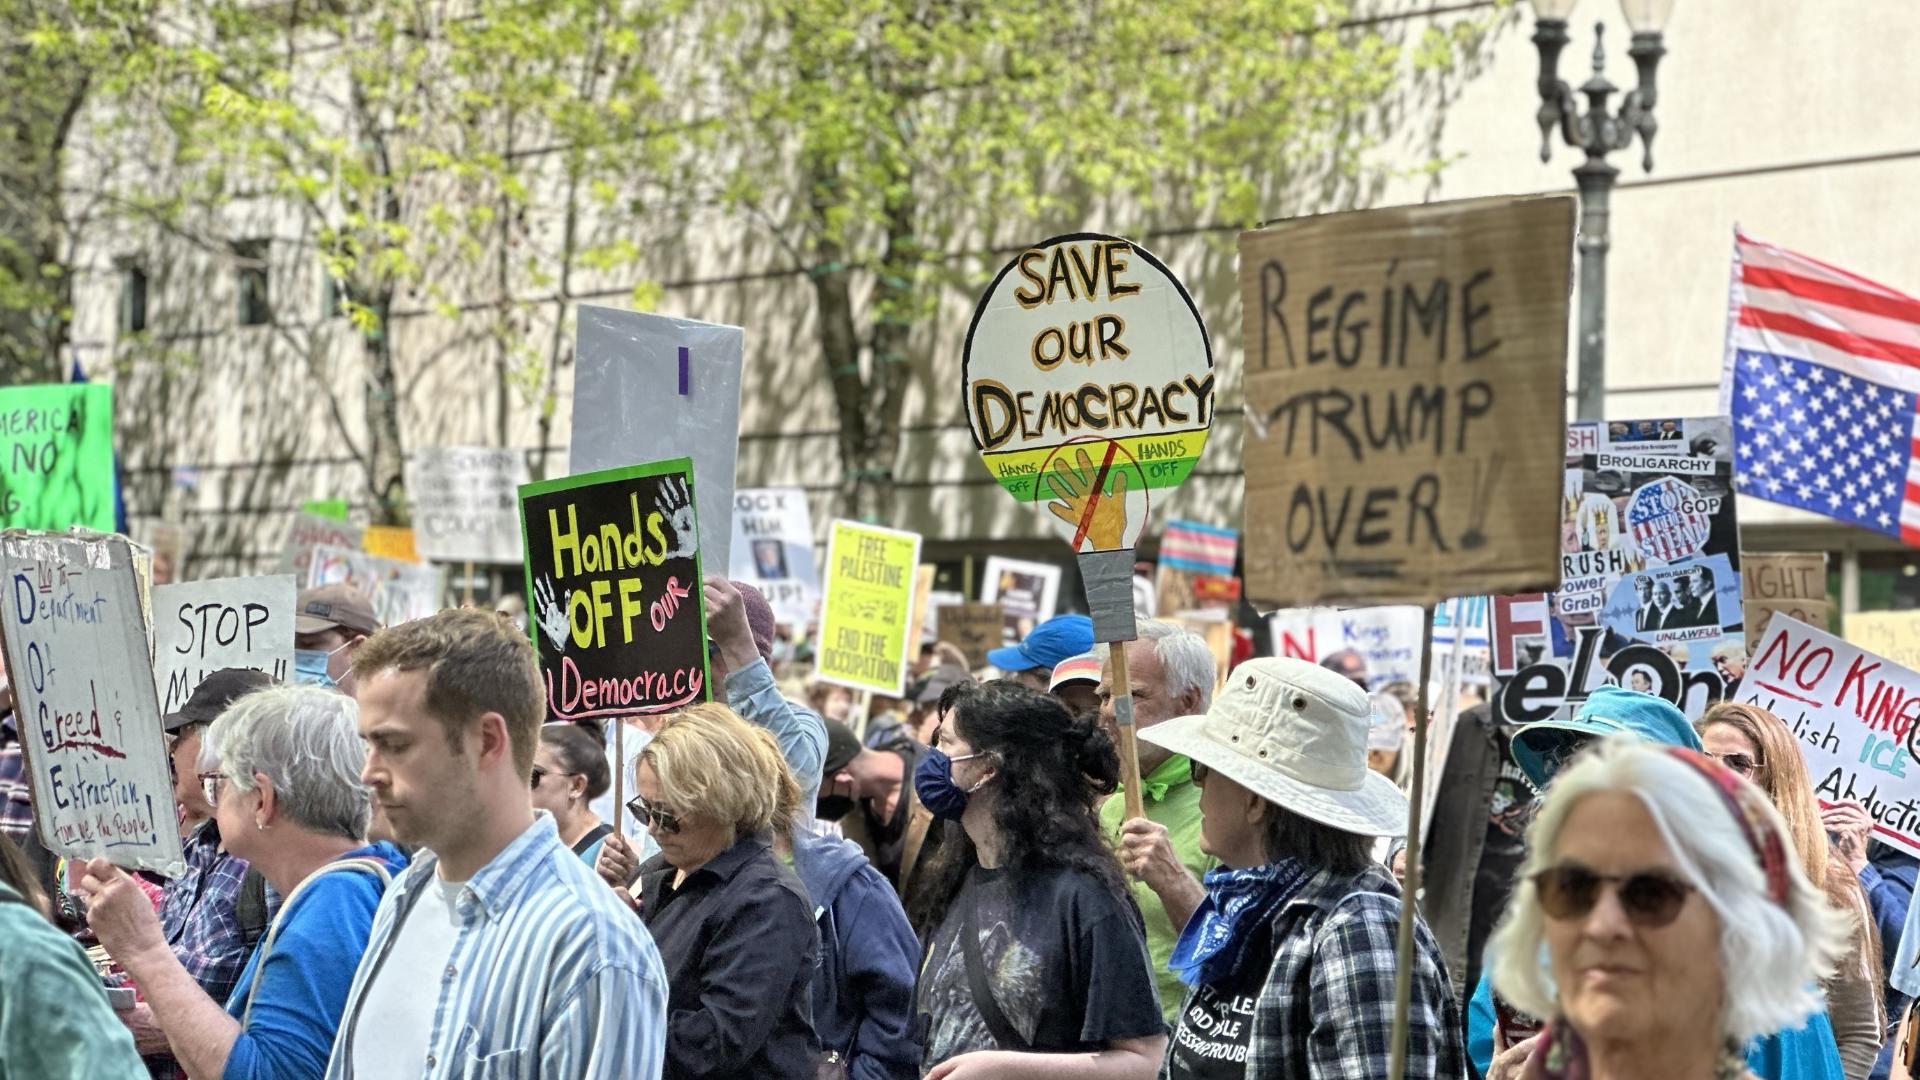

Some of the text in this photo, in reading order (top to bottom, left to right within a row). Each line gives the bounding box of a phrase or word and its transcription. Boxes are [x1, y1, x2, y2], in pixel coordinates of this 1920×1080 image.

[1014, 239, 1143, 310] SAVE
[1030, 313, 1132, 371] OUR
[972, 373, 1215, 452] DEMOCRACY
[1265, 379, 1495, 464] TRUMP
[12, 440, 59, 475] NO
[1137, 439, 1187, 461] HANDS
[1597, 453, 1711, 472] BROLIGARCHY
[998, 462, 1038, 477] HANDS
[1008, 479, 1031, 493] OFF
[1150, 461, 1180, 478] OFF
[734, 494, 786, 512] OCK
[1681, 498, 1720, 515] GOP
[547, 491, 668, 579] Hands
[857, 534, 887, 561] FREE
[837, 555, 904, 590] PALESTINE
[1747, 564, 1826, 600] IGHT
[13, 574, 107, 634] Department
[568, 577, 644, 650] OFF
[1561, 591, 1602, 612] Grab
[175, 602, 270, 658] STOP
[837, 626, 888, 658] END THE
[1655, 626, 1721, 643] UNLAWFUL
[822, 648, 900, 685] OCCUPATION
[1753, 628, 1834, 691] NO
[562, 655, 703, 713] Democracy
[38, 678, 102, 748] Greed
[1755, 693, 1840, 755] lish
[1858, 733, 1910, 779] ICE
[50, 763, 140, 810] Extraction
